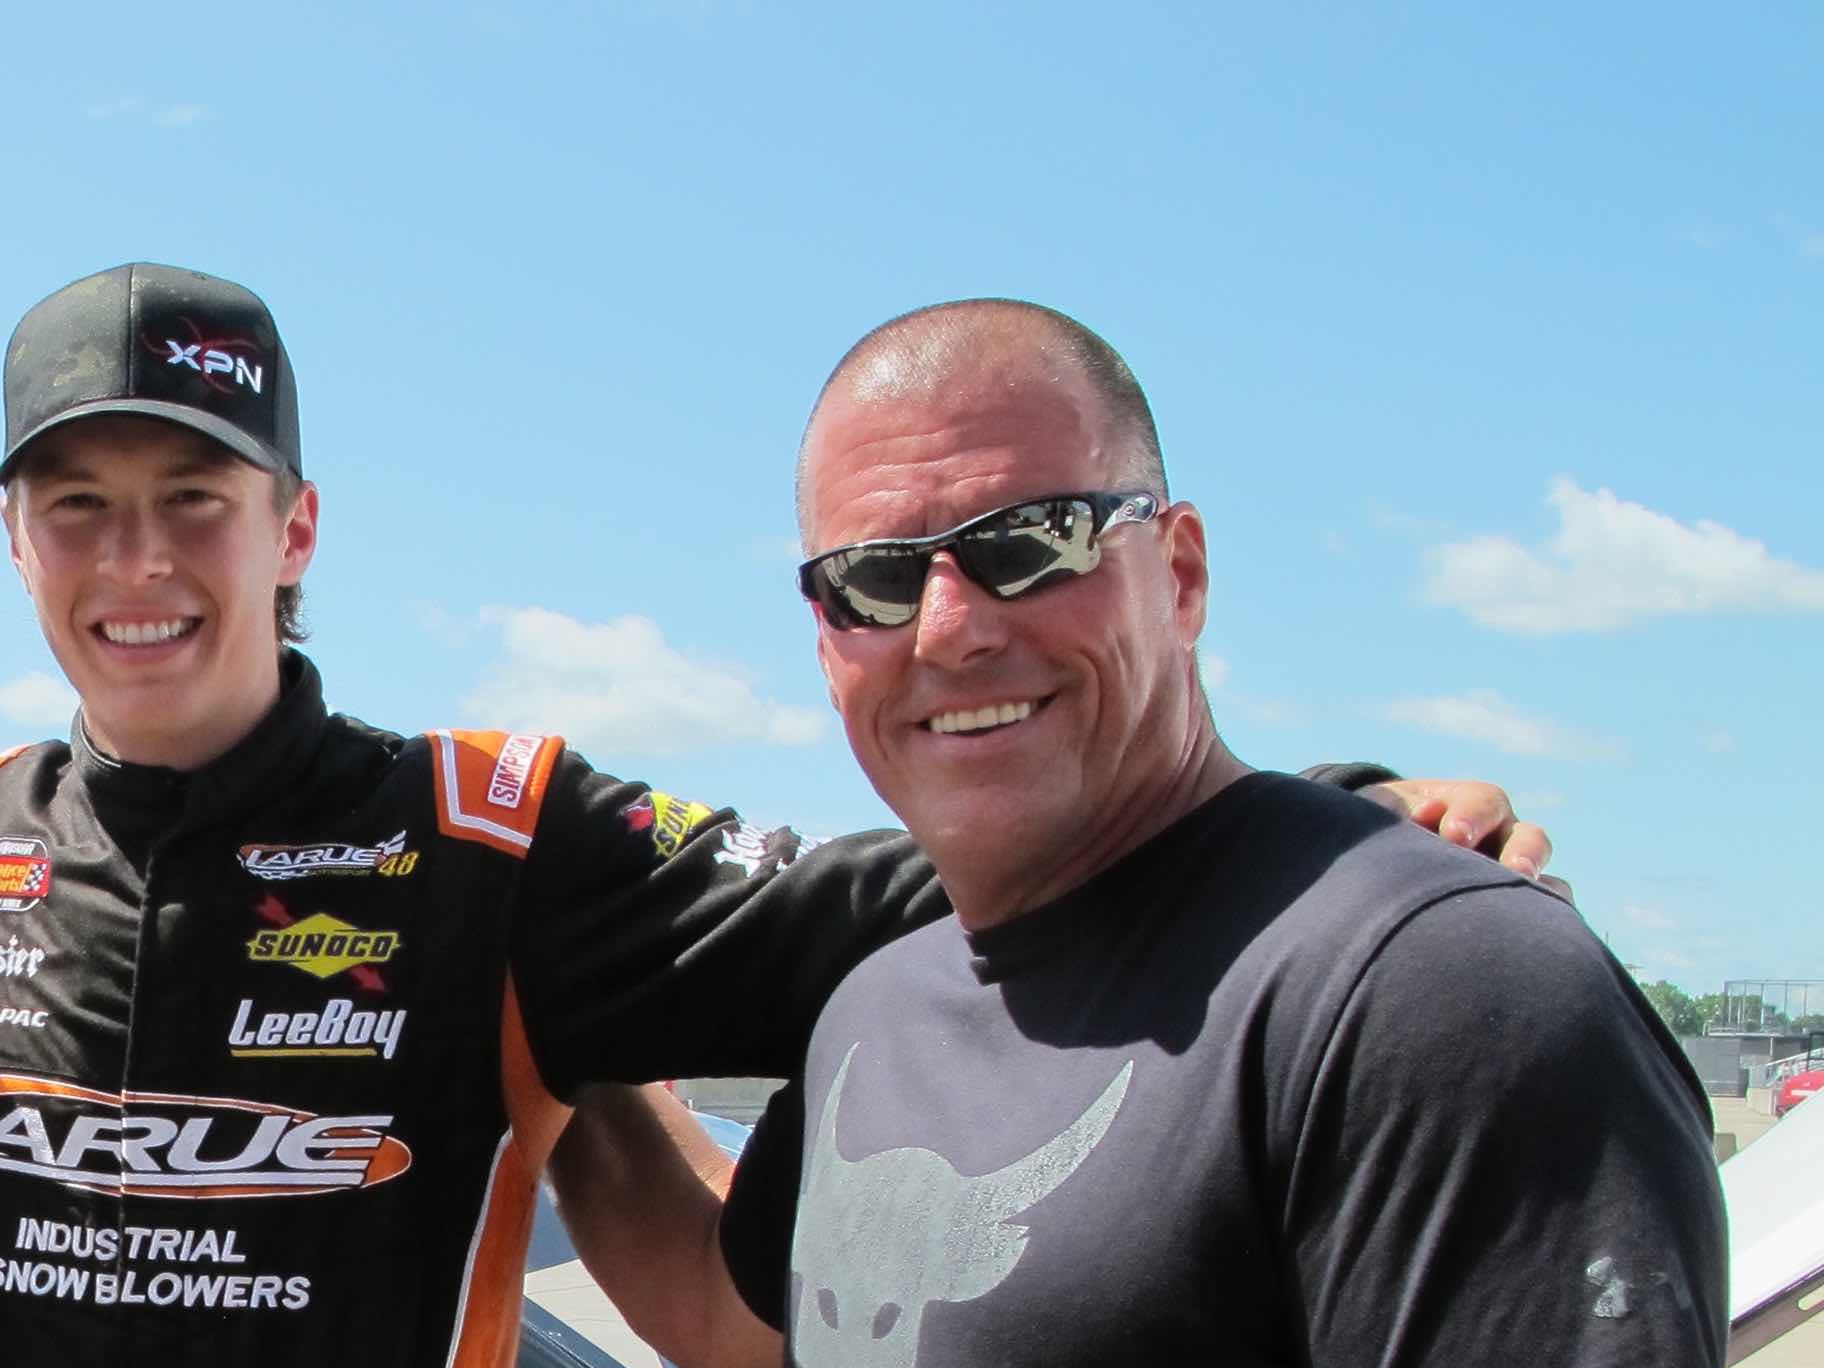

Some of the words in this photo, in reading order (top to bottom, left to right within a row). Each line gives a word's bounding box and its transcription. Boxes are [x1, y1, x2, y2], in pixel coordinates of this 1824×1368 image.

[165, 338, 263, 395] XPN
[245, 846, 382, 870] LARUE
[378, 851, 420, 876] 48
[252, 932, 394, 958] SUNOCO
[228, 998, 407, 1060] LeeBoy
[14, 1216, 247, 1264] INDUSTRIAL
